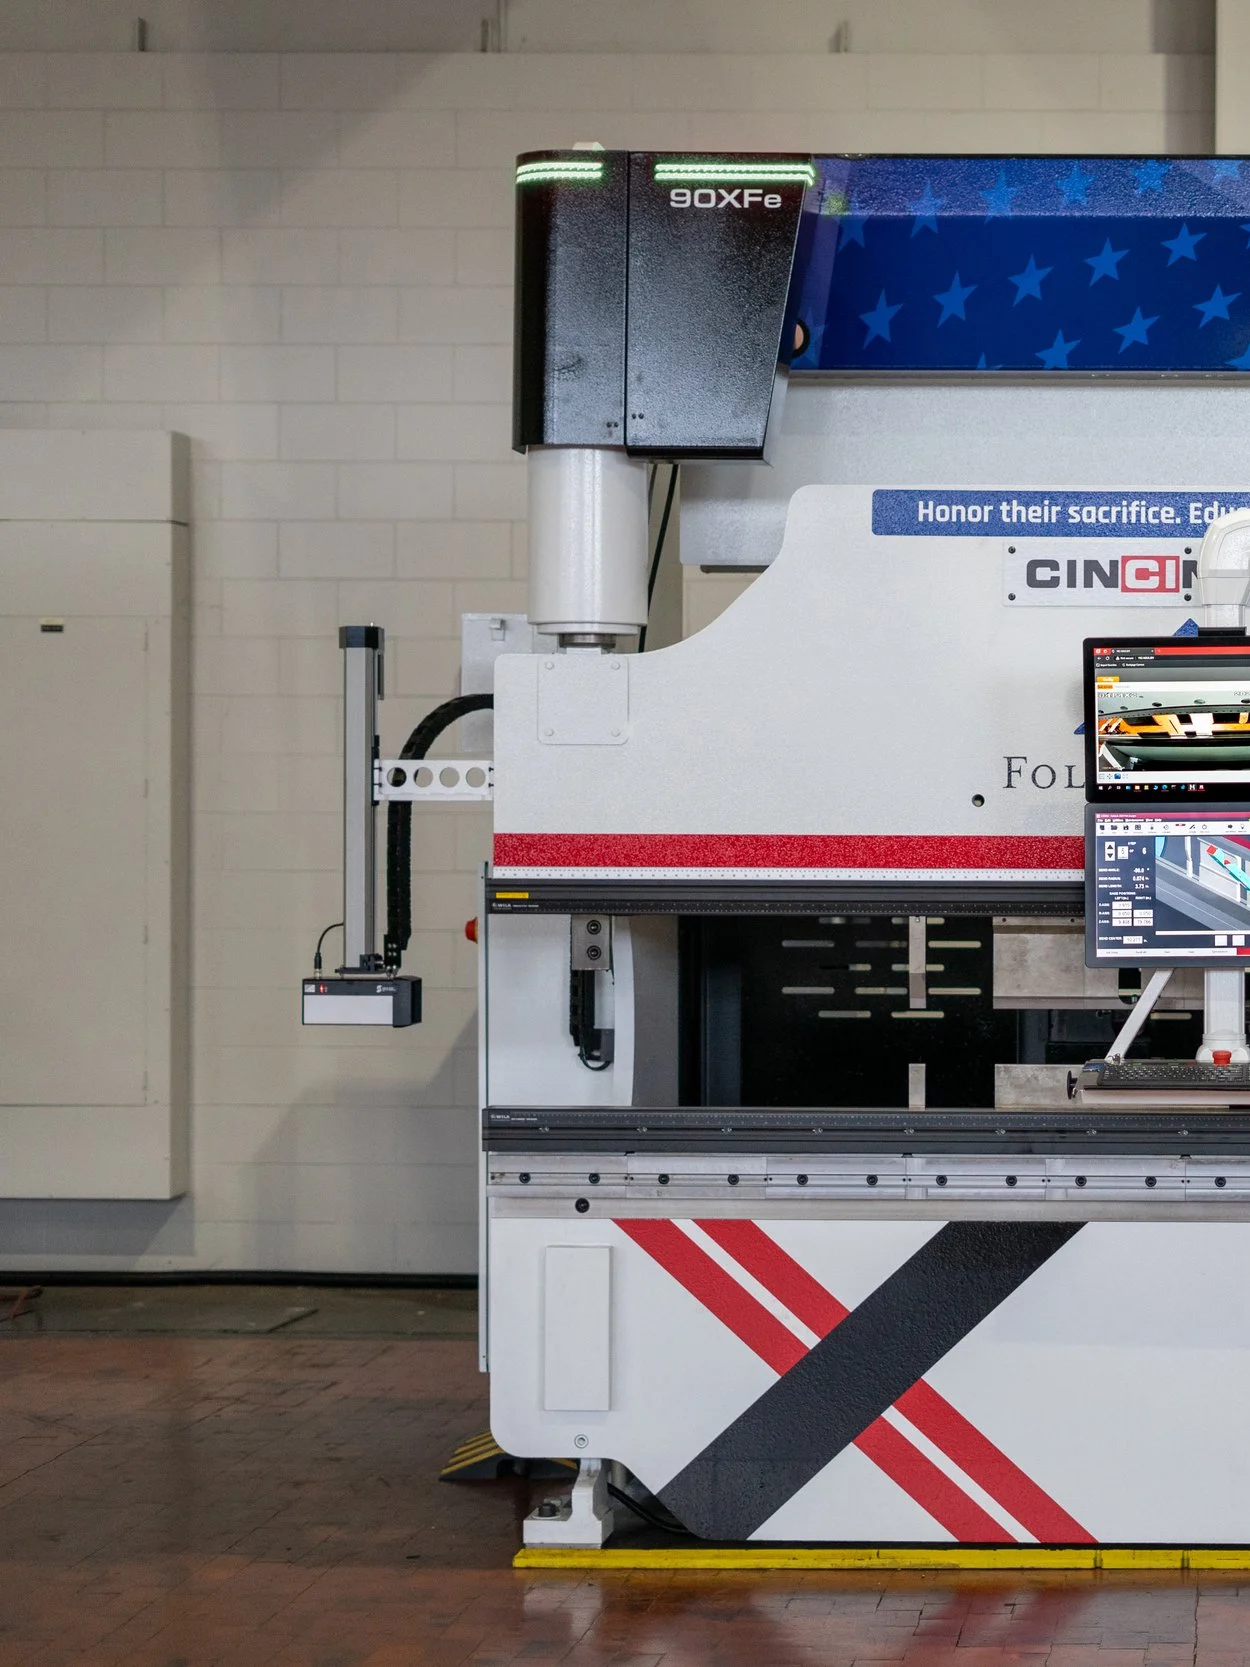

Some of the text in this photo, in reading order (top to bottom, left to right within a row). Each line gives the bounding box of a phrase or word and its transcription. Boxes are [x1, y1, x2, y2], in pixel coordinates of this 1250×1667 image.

[669, 188, 782, 208] 90XFe
[917, 500, 994, 523] Honor
[1000, 499, 1063, 524] their
[1067, 500, 1181, 524] sacrifice.
